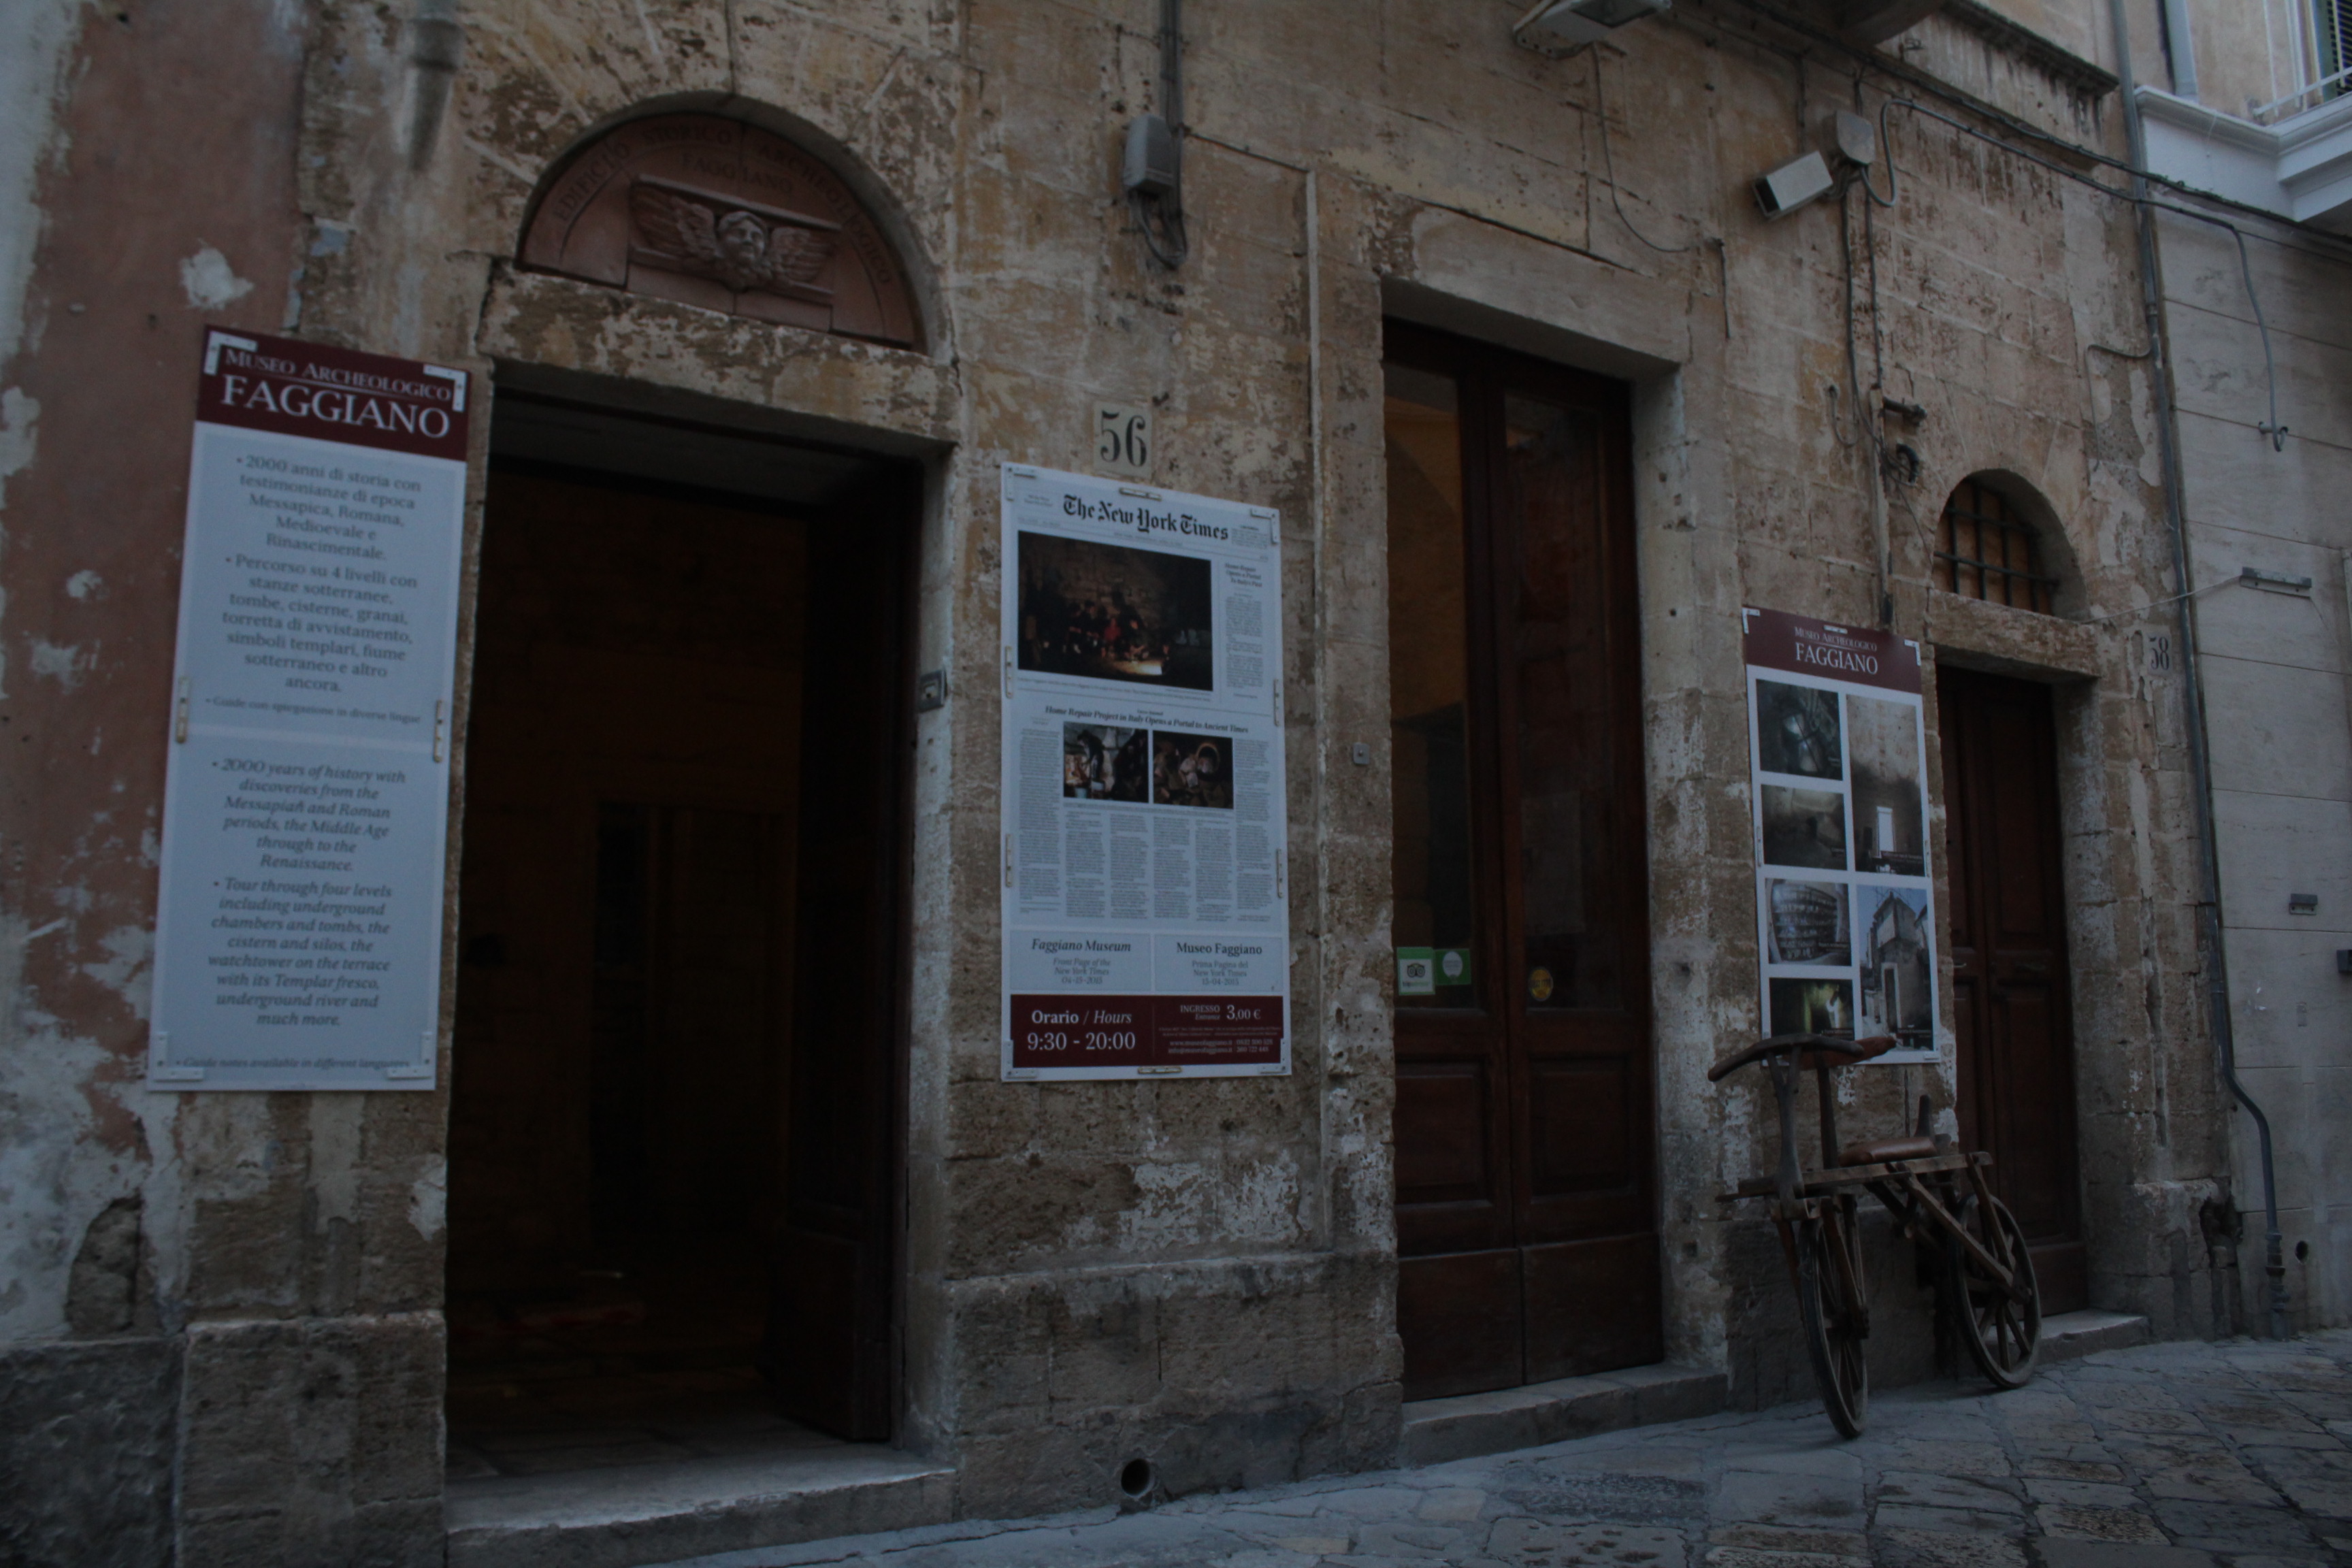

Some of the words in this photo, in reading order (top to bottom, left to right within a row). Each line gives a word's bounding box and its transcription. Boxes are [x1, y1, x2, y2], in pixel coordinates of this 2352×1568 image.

[225, 347, 296, 374] MUSEO
[301, 362, 452, 401] ARCHEOLOGICO
[221, 374, 450, 438] FAGGIANO
[1100, 410, 1147, 467] 56
[246, 455, 289, 472] 2000
[290, 464, 325, 478] anni
[328, 467, 344, 481] di
[347, 472, 390, 487] storia
[393, 479, 421, 492] con
[239, 474, 348, 500] testimonianze
[352, 489, 368, 502] di
[370, 494, 415, 509] epoca
[249, 492, 333, 517] Messapica,
[338, 505, 404, 527] Romana,
[1062, 493, 1095, 519] The
[1097, 500, 1133, 524] New
[1137, 507, 1177, 534] York
[1179, 513, 1228, 540] Times
[276, 514, 364, 539] Medioevale
[367, 531, 376, 540] e
[265, 532, 385, 559] Rinascimentale.
[235, 553, 306, 574] Percorso
[310, 566, 328, 577] su
[331, 566, 341, 579] 4
[344, 567, 387, 584] livelli
[389, 576, 417, 588] con
[248, 576, 299, 593] stanze
[303, 584, 392, 604] sotterranee,
[229, 592, 284, 611] tombe,
[287, 600, 353, 619] cisterne,
[357, 609, 407, 625] granai,
[221, 611, 283, 630] torretta
[287, 617, 302, 631] di
[306, 622, 412, 644] avvistamento,
[1793, 625, 1820, 641] MUSEO
[1821, 632, 1877, 651] ARCHEOLOGICO
[226, 630, 287, 649] simboli
[289, 637, 359, 657] templari,
[363, 644, 406, 661] fiume
[2149, 636, 2170, 670] 58
[244, 653, 336, 672] sotterraneo
[338, 664, 348, 674] e
[351, 662, 388, 676] altro
[1795, 641, 1878, 674] FAGGIANO
[284, 677, 341, 692] ancora.
[1045, 705, 1067, 715] Home
[1068, 708, 1093, 719] Repair
[1093, 710, 1119, 721] Project
[1128, 714, 1143, 723] Italy
[1144, 716, 1166, 725] Opens
[1173, 719, 1195, 728] Portal
[1203, 722, 1228, 731] Ancient
[1229, 724, 1248, 733] Times
[220, 757, 267, 774] 2000
[265, 764, 305, 777] years
[308, 764, 324, 780] of
[323, 765, 373, 783] history
[376, 770, 406, 783] with
[238, 777, 318, 795] discoveries
[317, 783, 354, 799] from
[356, 785, 379, 800] the
[306, 802, 336, 815] and
[338, 802, 390, 818] Roman
[222, 816, 280, 831] periods,
[283, 818, 308, 832] the
[310, 819, 362, 835] Middle
[364, 823, 389, 840] Age
[256, 834, 314, 853] through
[316, 840, 332, 852] to
[333, 839, 357, 853] the
[259, 853, 353, 871] Renaissance.
[225, 876, 259, 892] Tour
[260, 878, 318, 898] through
[318, 881, 351, 898] four
[353, 883, 392, 898] levels
[218, 896, 291, 915] including
[292, 900, 386, 918] underground
[210, 915, 284, 930] chambers
[285, 918, 316, 932] and
[317, 919, 364, 934] tombs,
[368, 921, 391, 934] the
[227, 936, 277, 949] cistern
[278, 936, 310, 950] and
[312, 937, 346, 951] silos,
[350, 938, 374, 952] the
[1031, 938, 1083, 953] Faggiano
[1085, 939, 1131, 951] Museum
[1176, 941, 1212, 953] Museo
[1214, 943, 1262, 957] Faggiano
[208, 953, 293, 968] watchtower
[294, 958, 314, 968] on
[316, 956, 340, 970] the
[342, 958, 390, 971] terrace
[216, 972, 249, 986] with
[252, 975, 271, 987] its
[274, 973, 333, 991] Templar
[332, 975, 379, 992] fresco,
[216, 992, 313, 1010] underground
[314, 994, 348, 1007] river
[349, 994, 379, 1008] and
[1179, 1004, 1220, 1013] INGRESSO
[1226, 1004, 1251, 1020] 3,00
[256, 1011, 299, 1025] much
[301, 1015, 340, 1026] more.
[1030, 1009, 1079, 1024] Orario
[1093, 1009, 1132, 1024] Hours
[1026, 1032, 1067, 1051] 9:30
[1085, 1031, 1136, 1050] 20:00
